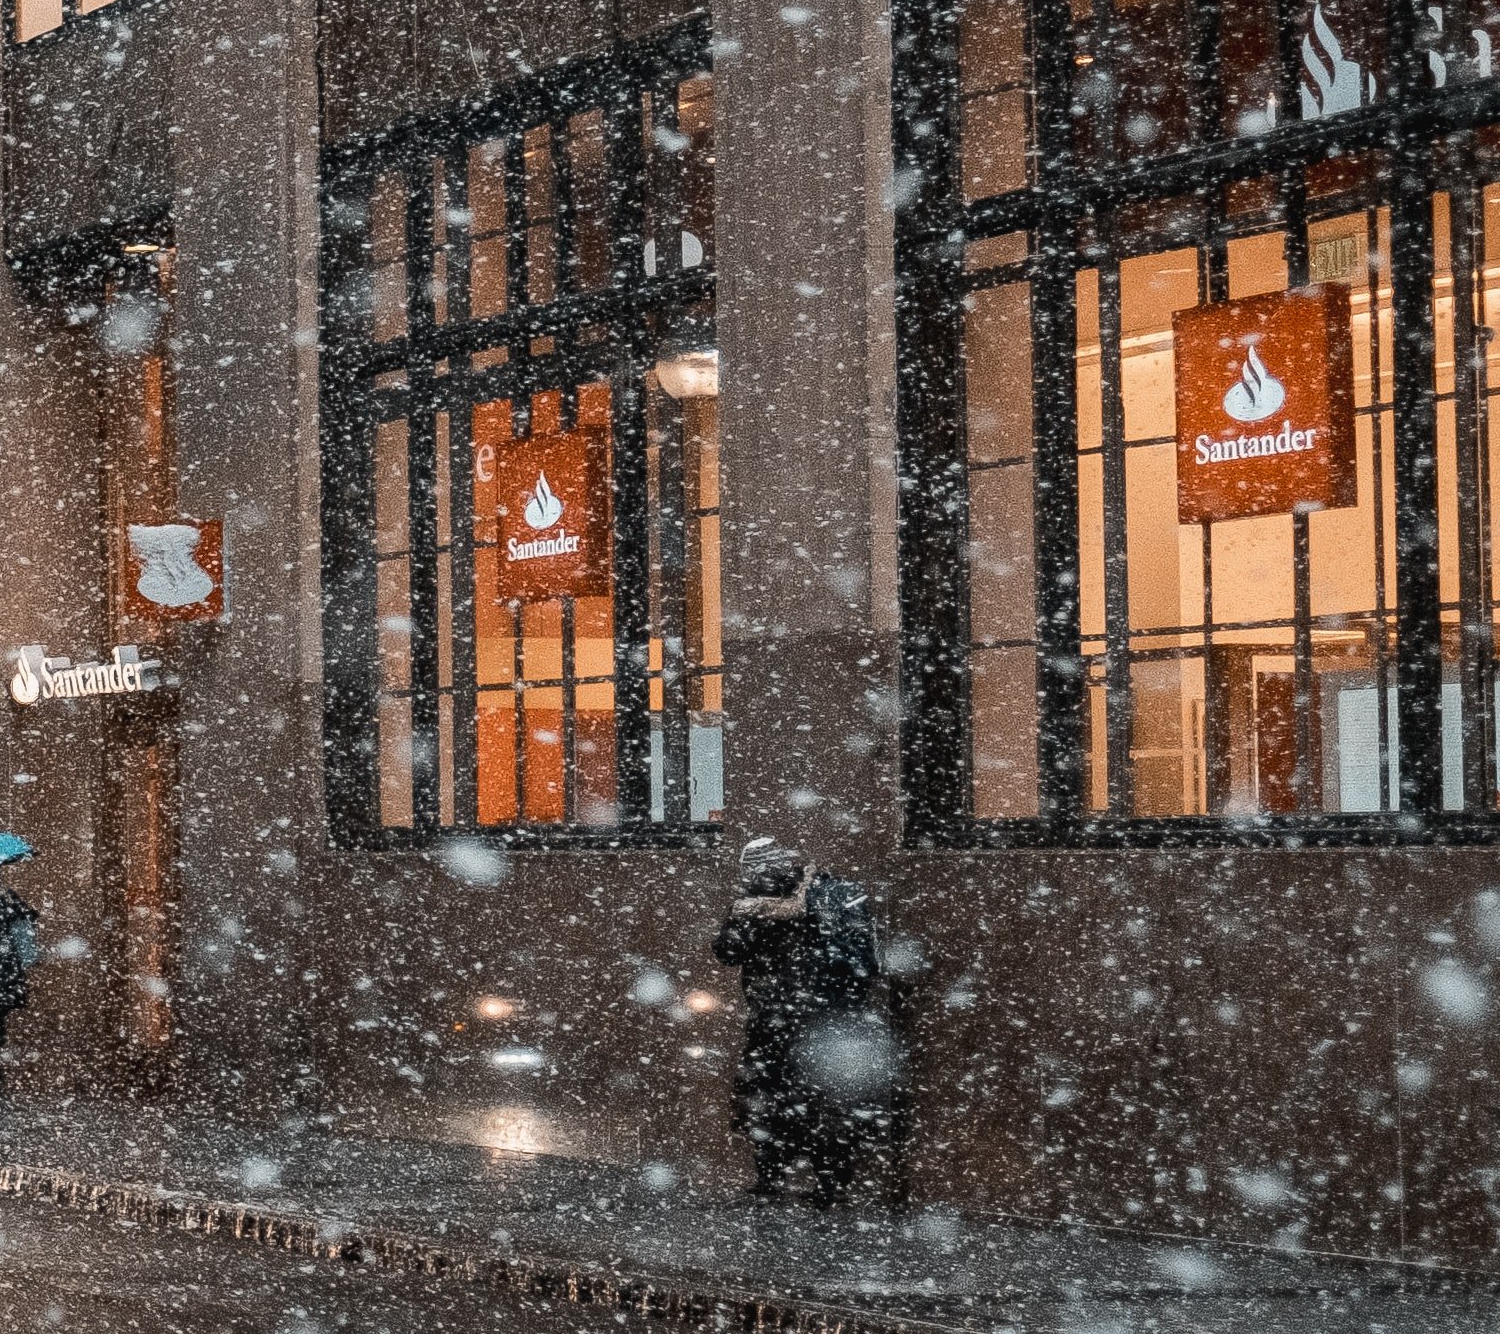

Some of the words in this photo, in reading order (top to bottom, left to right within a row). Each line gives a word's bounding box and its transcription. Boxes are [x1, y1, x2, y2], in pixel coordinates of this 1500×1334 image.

[1195, 420, 1316, 465] Santander
[507, 529, 580, 562] Santander
[41, 646, 143, 699] Santander
